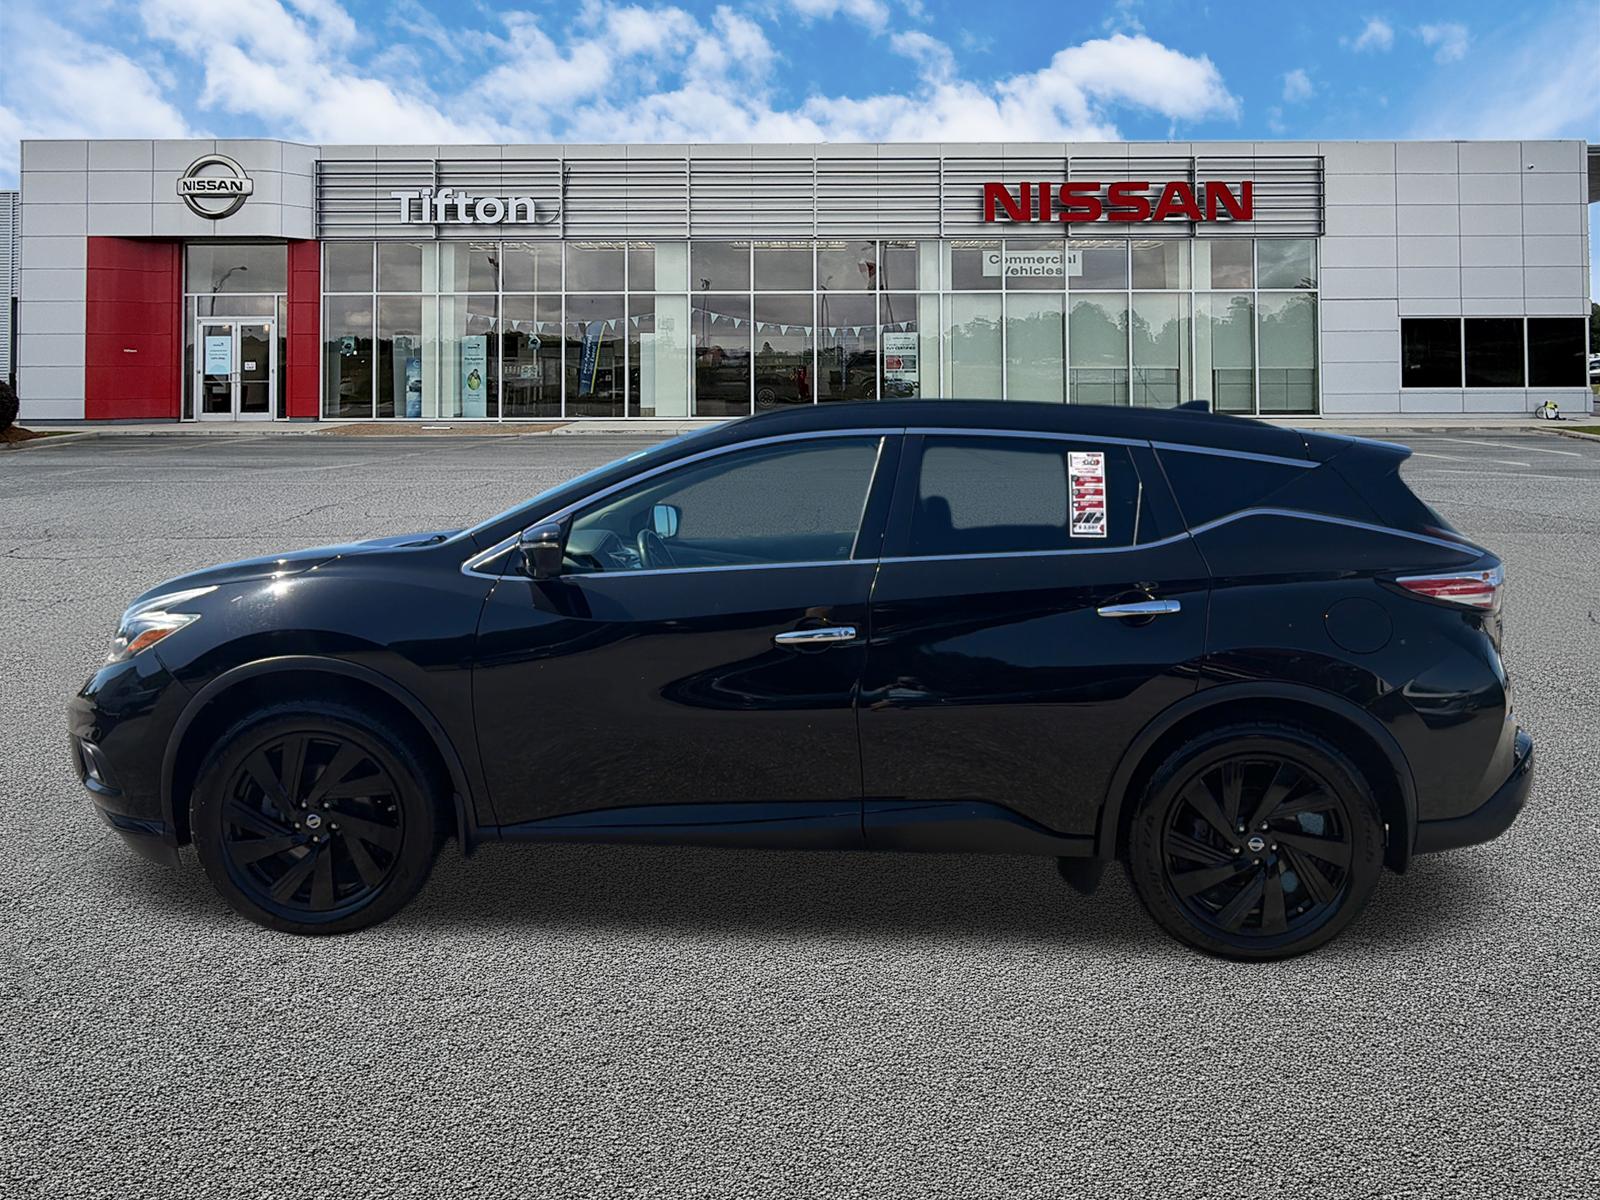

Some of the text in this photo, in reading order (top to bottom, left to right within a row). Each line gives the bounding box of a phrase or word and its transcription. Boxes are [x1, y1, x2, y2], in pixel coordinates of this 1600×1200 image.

[183, 180, 243, 191] NISSAN
[984, 181, 1253, 222] NISSAN
[391, 188, 536, 224] Tifton
